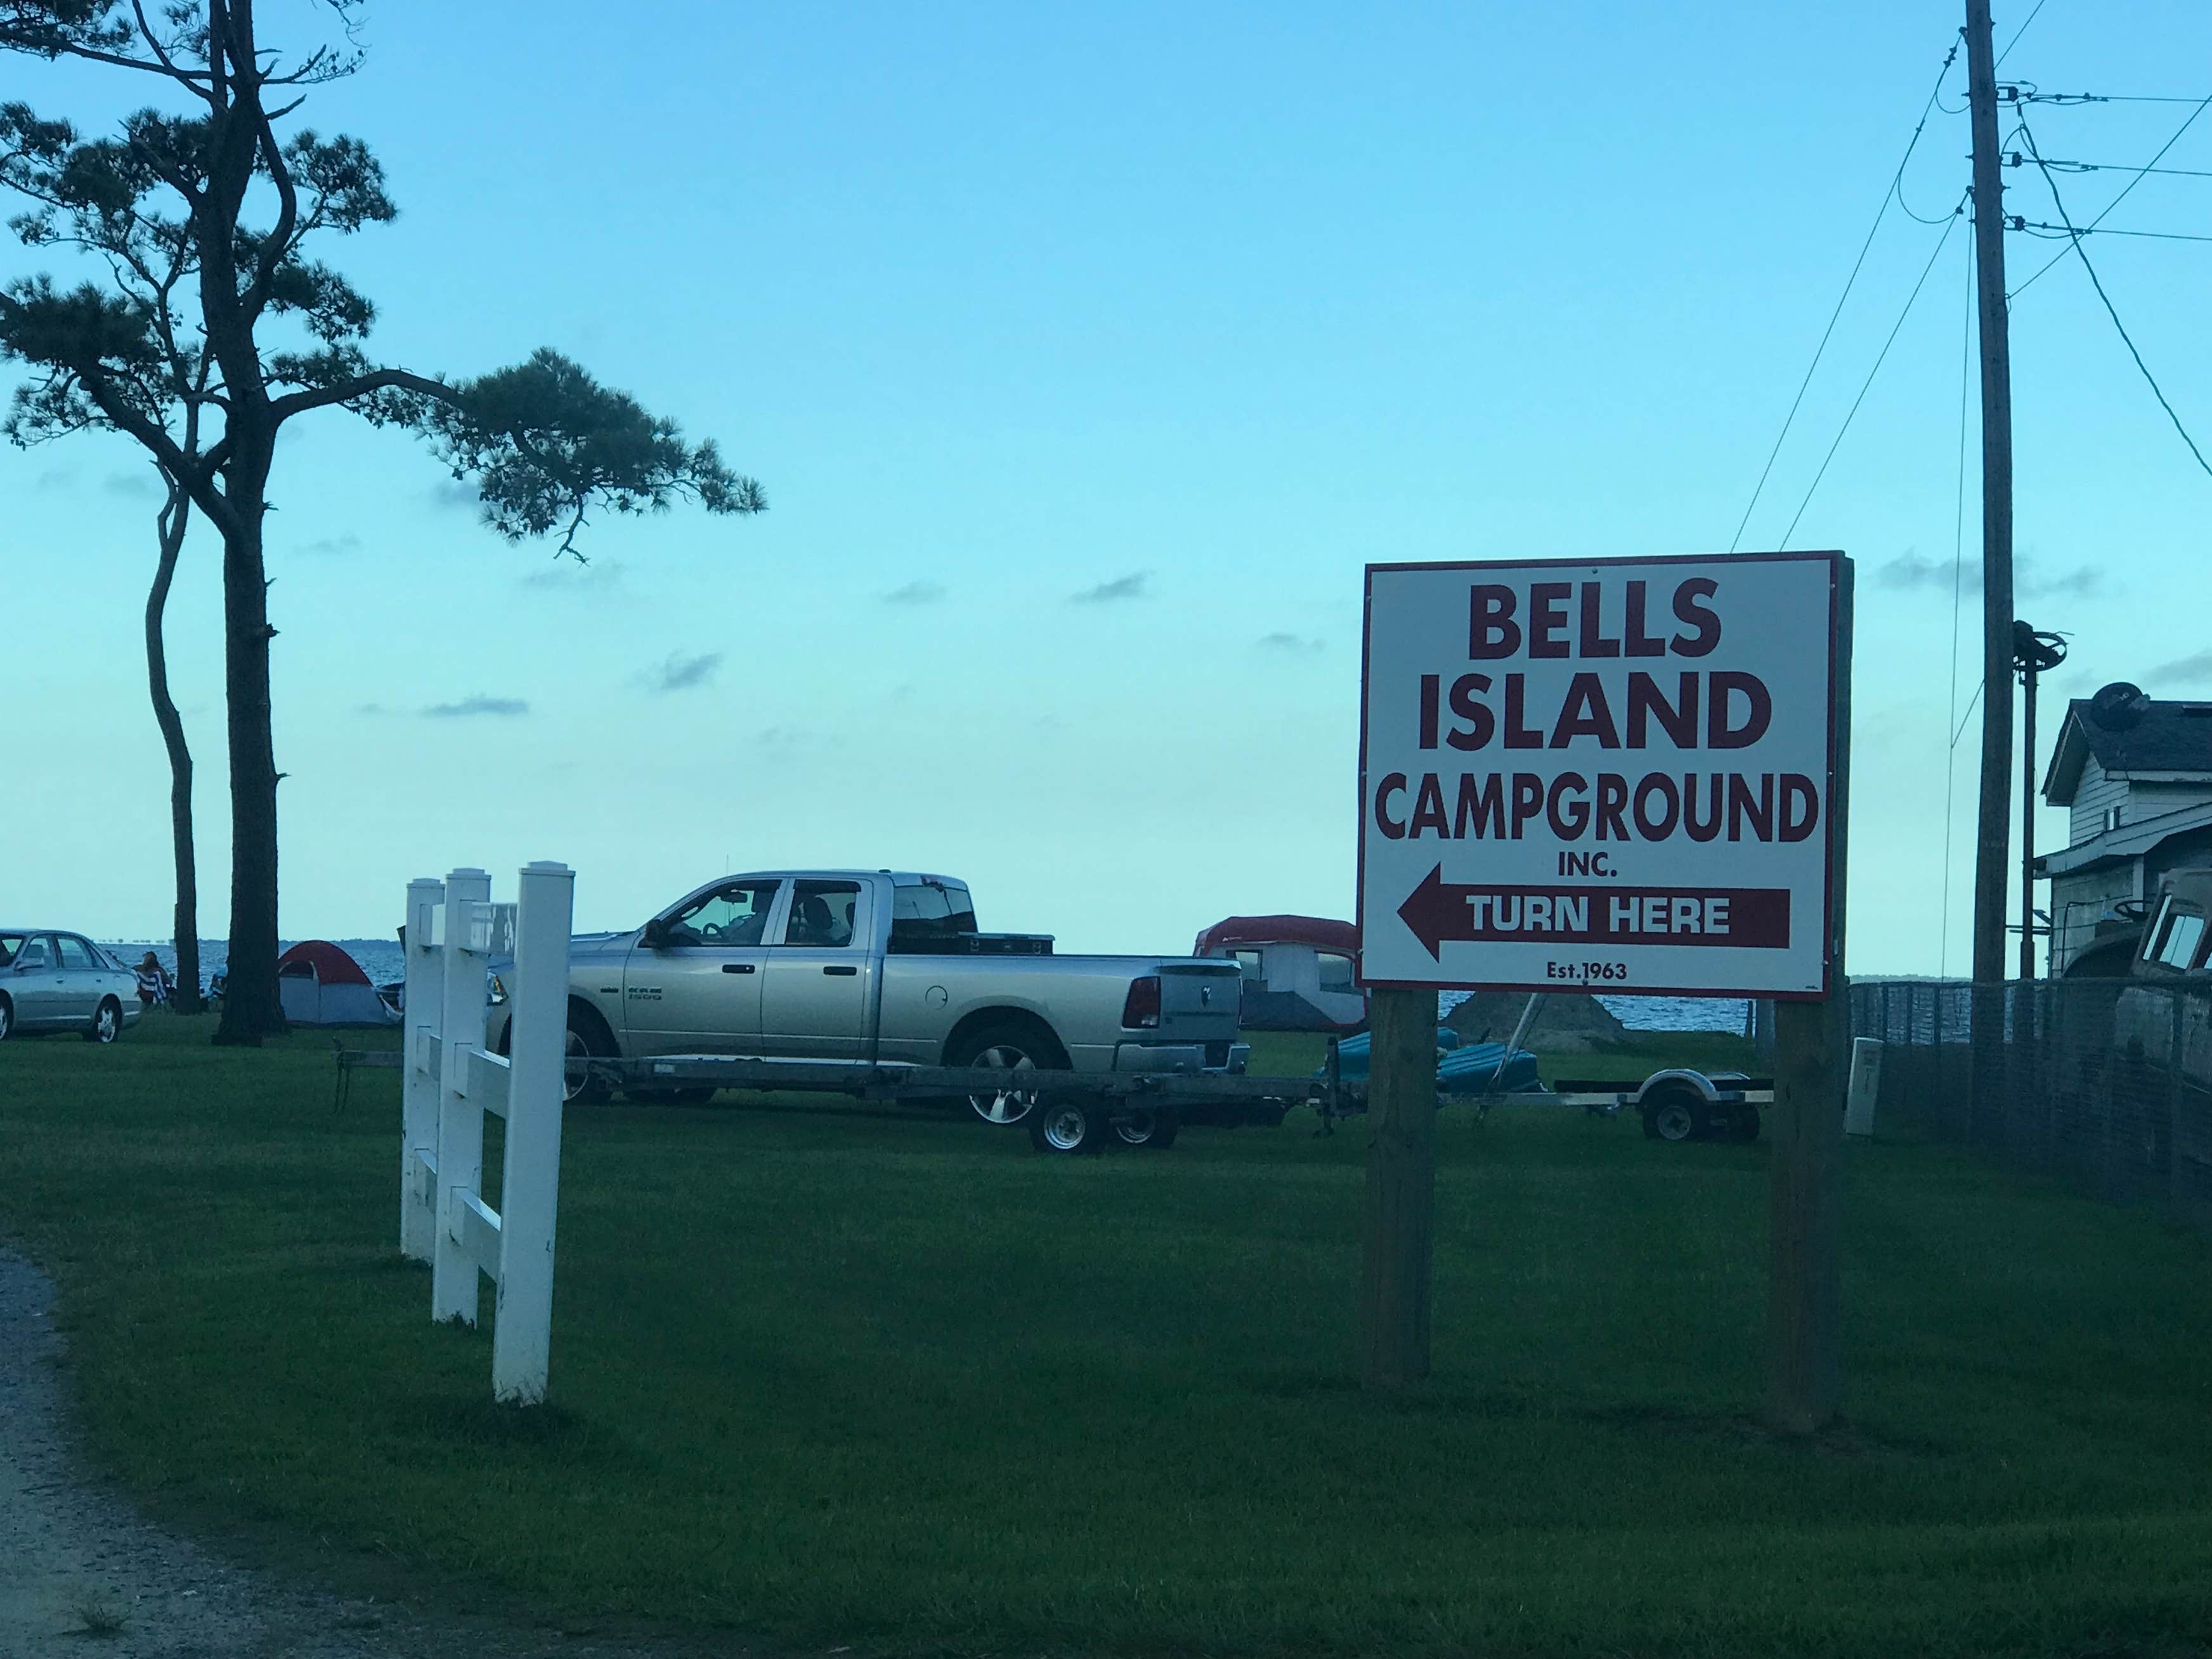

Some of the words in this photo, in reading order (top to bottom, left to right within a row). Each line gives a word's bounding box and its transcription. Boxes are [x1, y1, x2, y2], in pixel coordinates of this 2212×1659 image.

[1469, 577, 1722, 660] BELLS
[1419, 671, 1772, 751] ISLAND
[1374, 771, 1819, 843] CAMPGROUND
[1558, 851, 1618, 877] INC.
[1466, 895, 1589, 932] TURN
[1609, 896, 1730, 934] HERE
[1547, 961, 1627, 980] Est.1963
